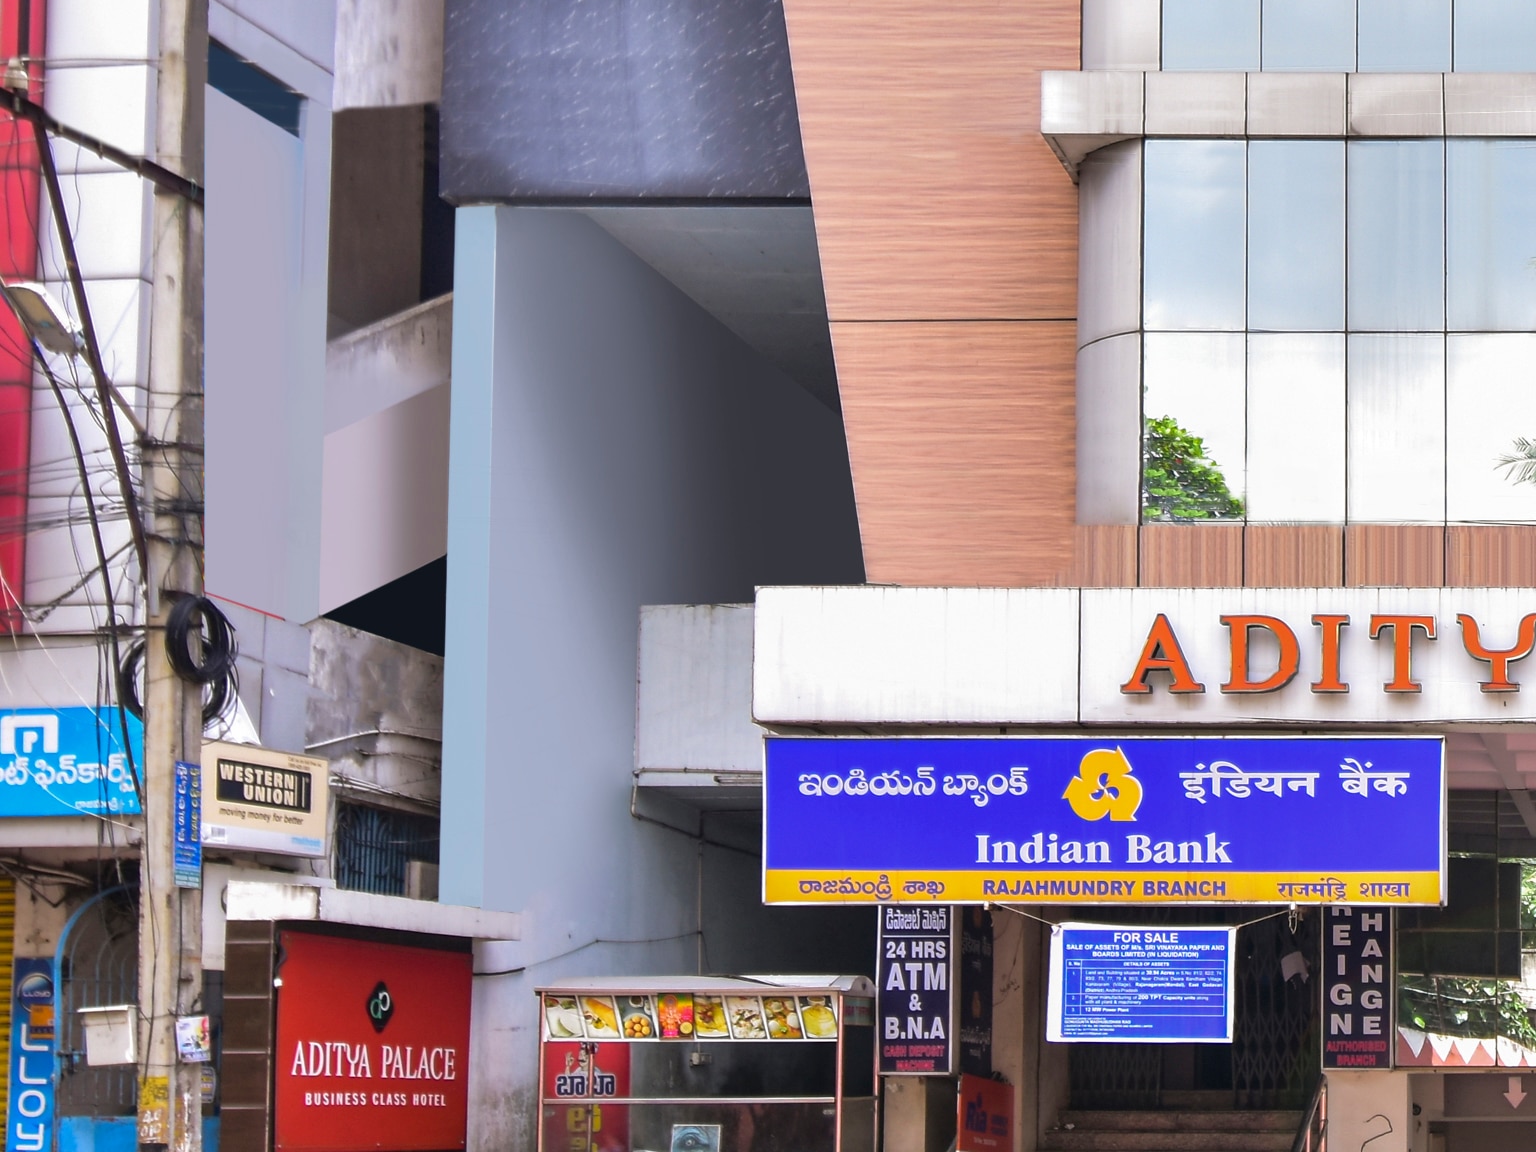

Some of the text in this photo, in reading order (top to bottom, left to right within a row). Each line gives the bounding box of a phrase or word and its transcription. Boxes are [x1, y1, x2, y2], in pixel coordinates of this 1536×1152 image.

[220, 763, 294, 806] WESTERN UNION
[798, 767, 1028, 807] ఇండియన్ బ్యాంక్
[1179, 757, 1410, 805] इंडियन बैंक
[248, 810, 271, 822] money
[273, 813, 284, 822] for
[975, 832, 1232, 864] Indian Bank
[799, 874, 945, 899] రాజమండ్రి శాఖ
[983, 880, 1226, 896] RAJAHMUNDRY BRANCH
[1360, 882, 1410, 898] शाखा
[1113, 932, 1179, 944] FOR SALE
[886, 941, 946, 958] 24 HRS
[886, 963, 946, 991] ATM
[909, 994, 922, 1011] &
[885, 1017, 945, 1039] B.N.A
[291, 1041, 456, 1080] ADITYA PALACE
[305, 1092, 446, 1107] BUSINESS CLASS HOTEL
